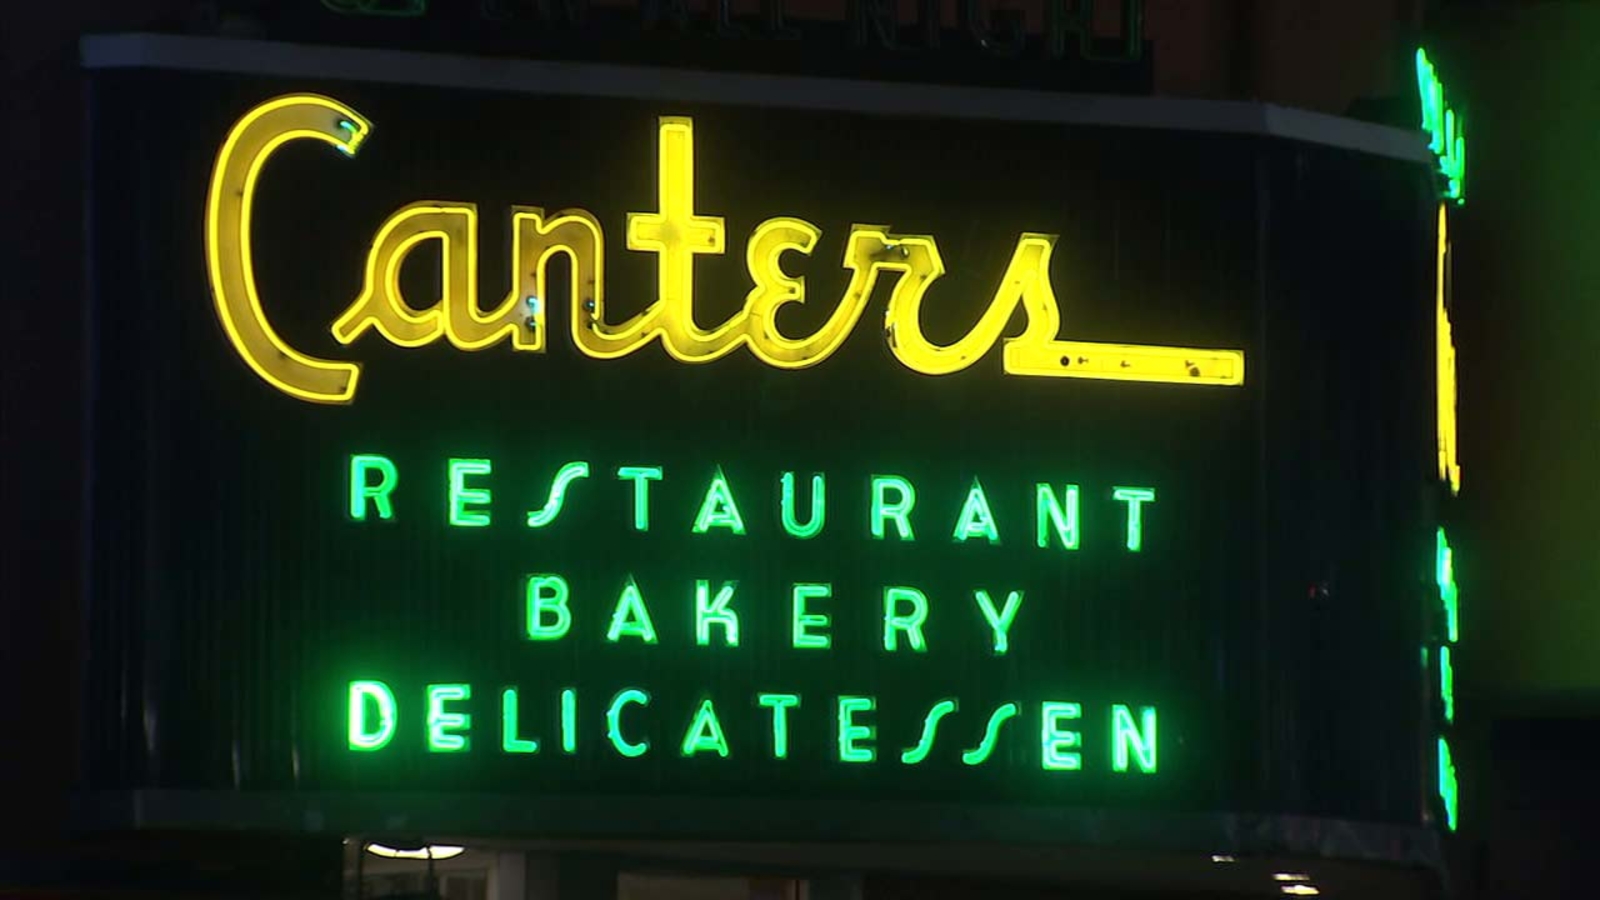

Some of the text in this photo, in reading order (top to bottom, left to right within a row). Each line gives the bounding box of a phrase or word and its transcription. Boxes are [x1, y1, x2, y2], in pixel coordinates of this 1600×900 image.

[206, 93, 1245, 404] Canters
[350, 454, 1156, 552] RESTAURANT
[525, 573, 1023, 654] BAKERY
[347, 679, 1160, 773] DELICATESSEN
